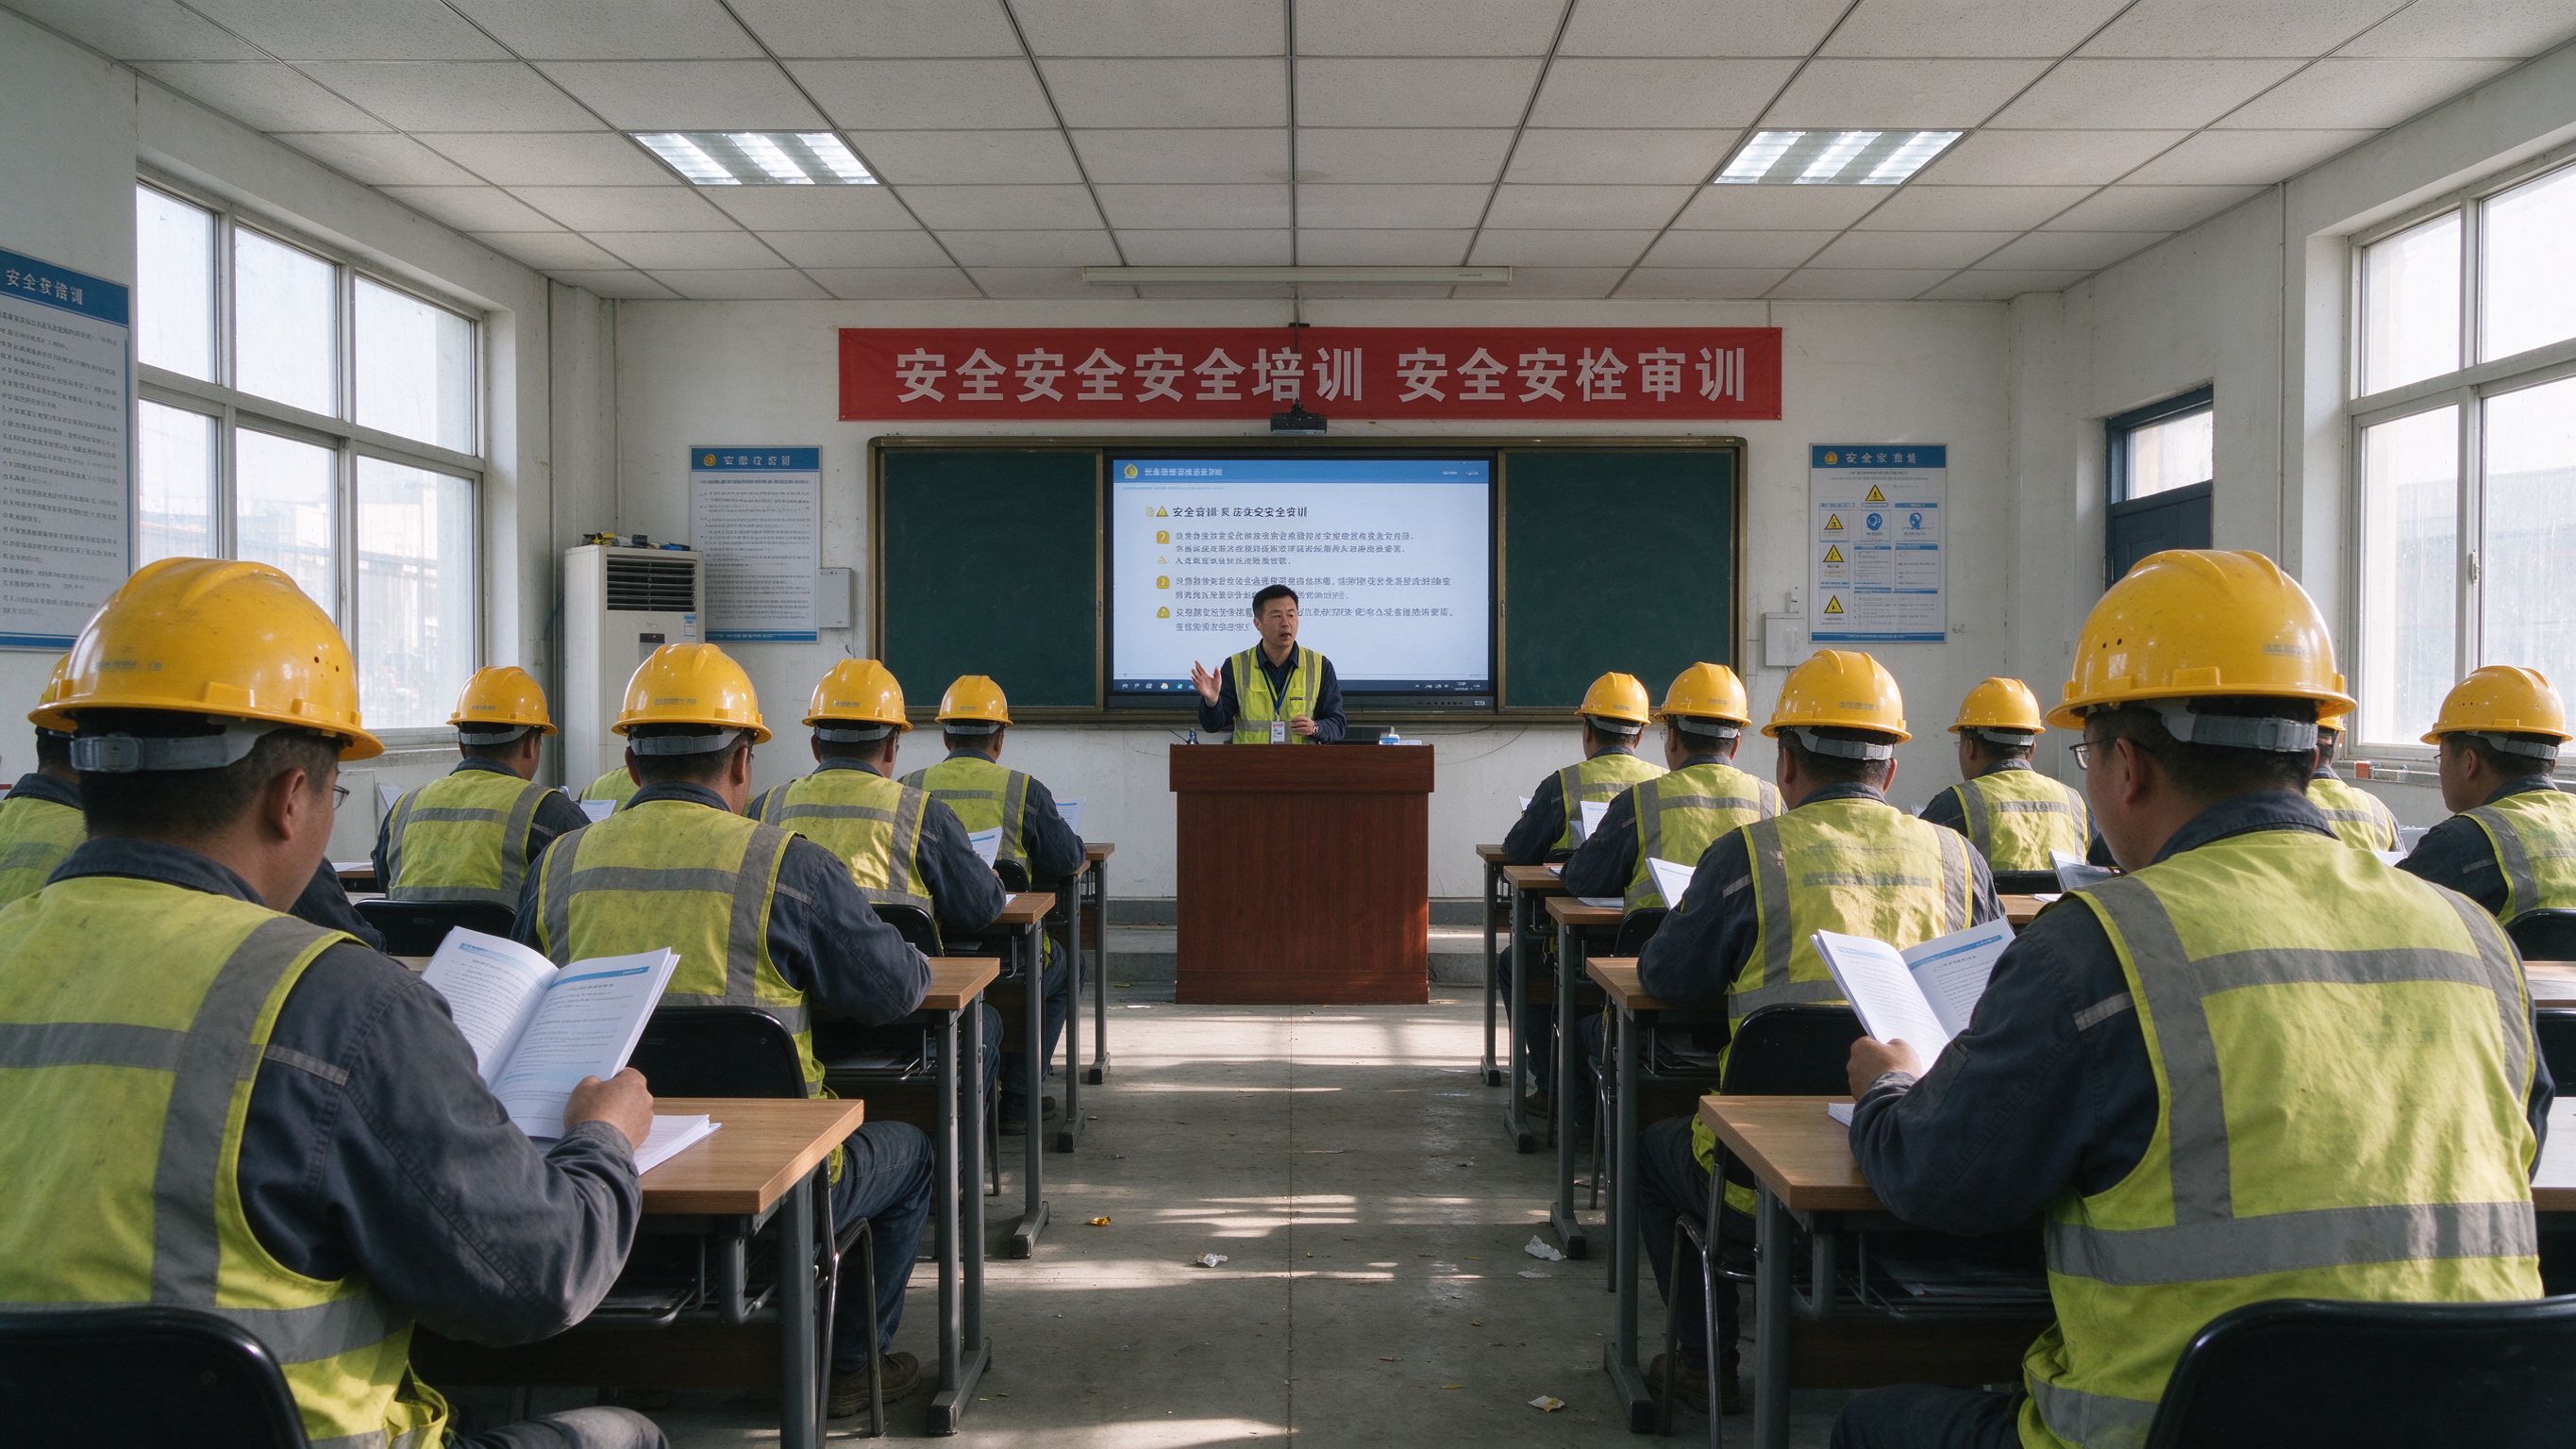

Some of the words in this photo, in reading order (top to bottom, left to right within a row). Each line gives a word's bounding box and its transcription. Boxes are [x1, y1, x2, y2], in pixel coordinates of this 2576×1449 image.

[895, 347, 1362, 403] 安全安全安全培训
